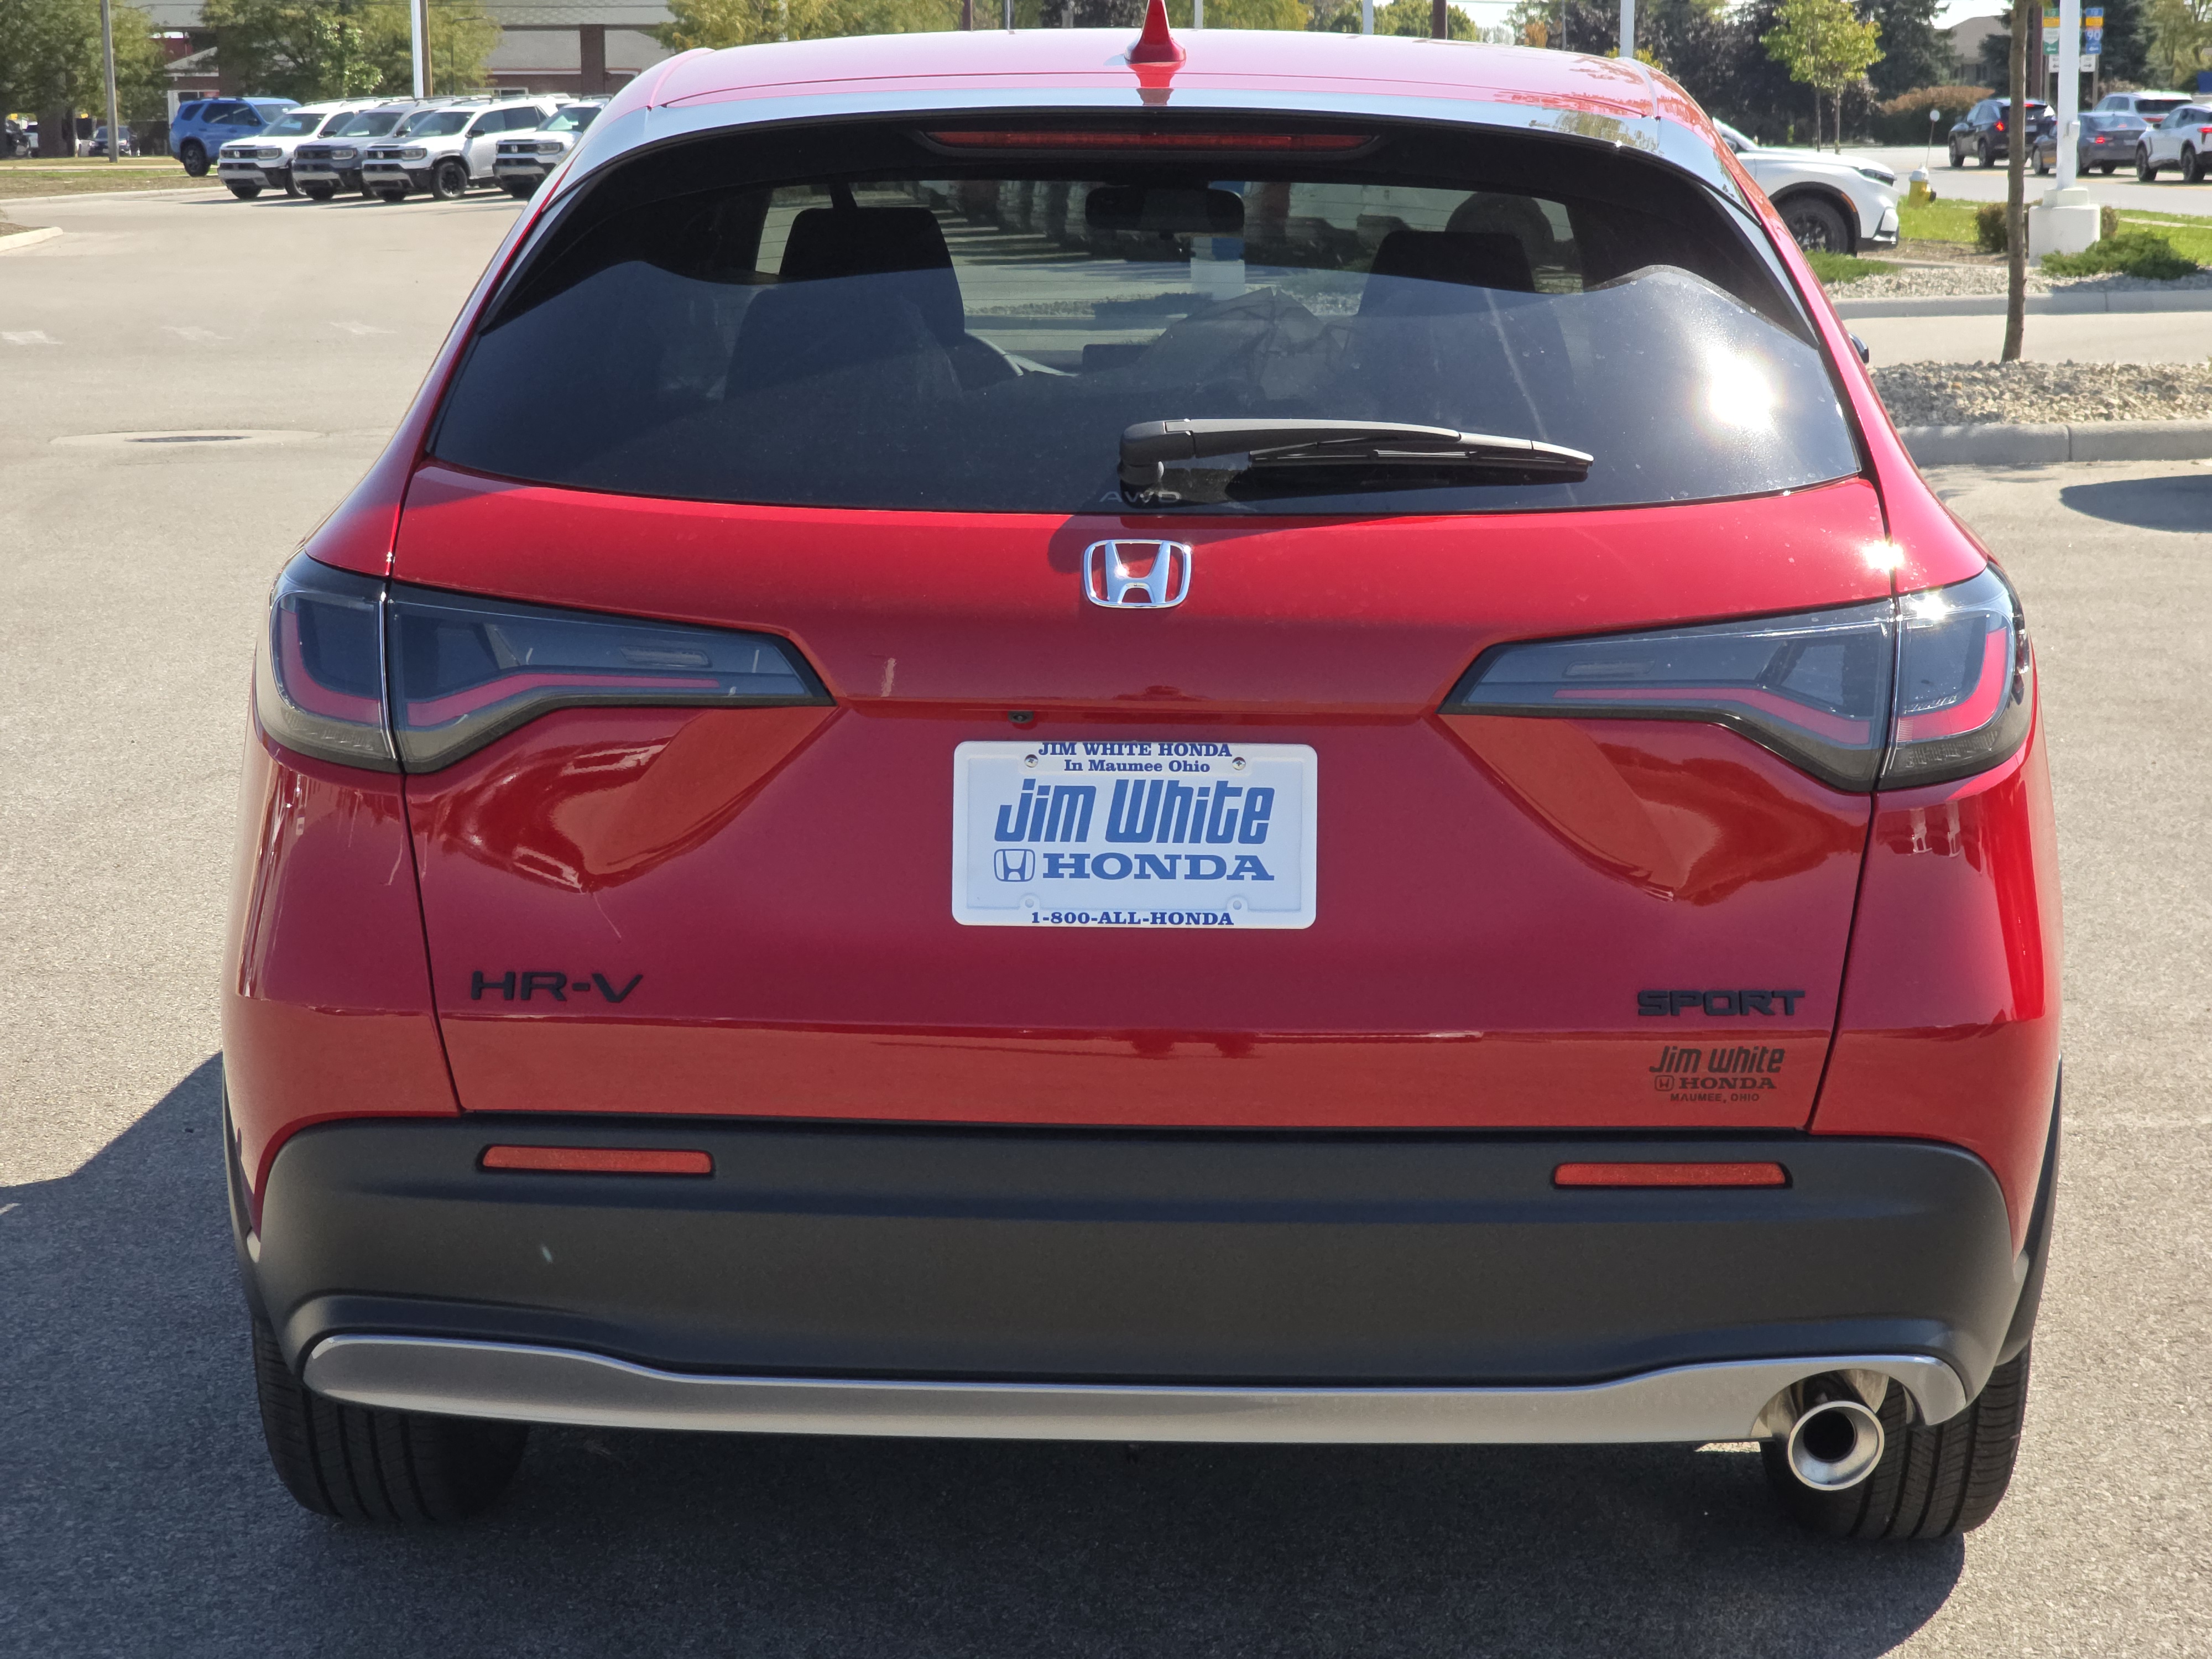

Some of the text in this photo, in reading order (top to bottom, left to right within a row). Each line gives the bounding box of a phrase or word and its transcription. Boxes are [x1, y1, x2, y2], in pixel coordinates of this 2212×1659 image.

[1099, 491, 1181, 503] AWD
[1039, 742, 1233, 757] JIM WHITE HONDA
[1065, 760, 1210, 773] In Maumee Ohio
[1105, 779, 1275, 844] White
[1042, 852, 1275, 880] HONDA
[1031, 912, 1234, 925] 1-800-ALL-HONDA
[471, 971, 644, 1003] HR-V
[1637, 990, 1806, 1016] SPORT
[1678, 1077, 1777, 1089] HONDA
[1670, 1093, 1760, 1103] MAUMEE, OHIO
